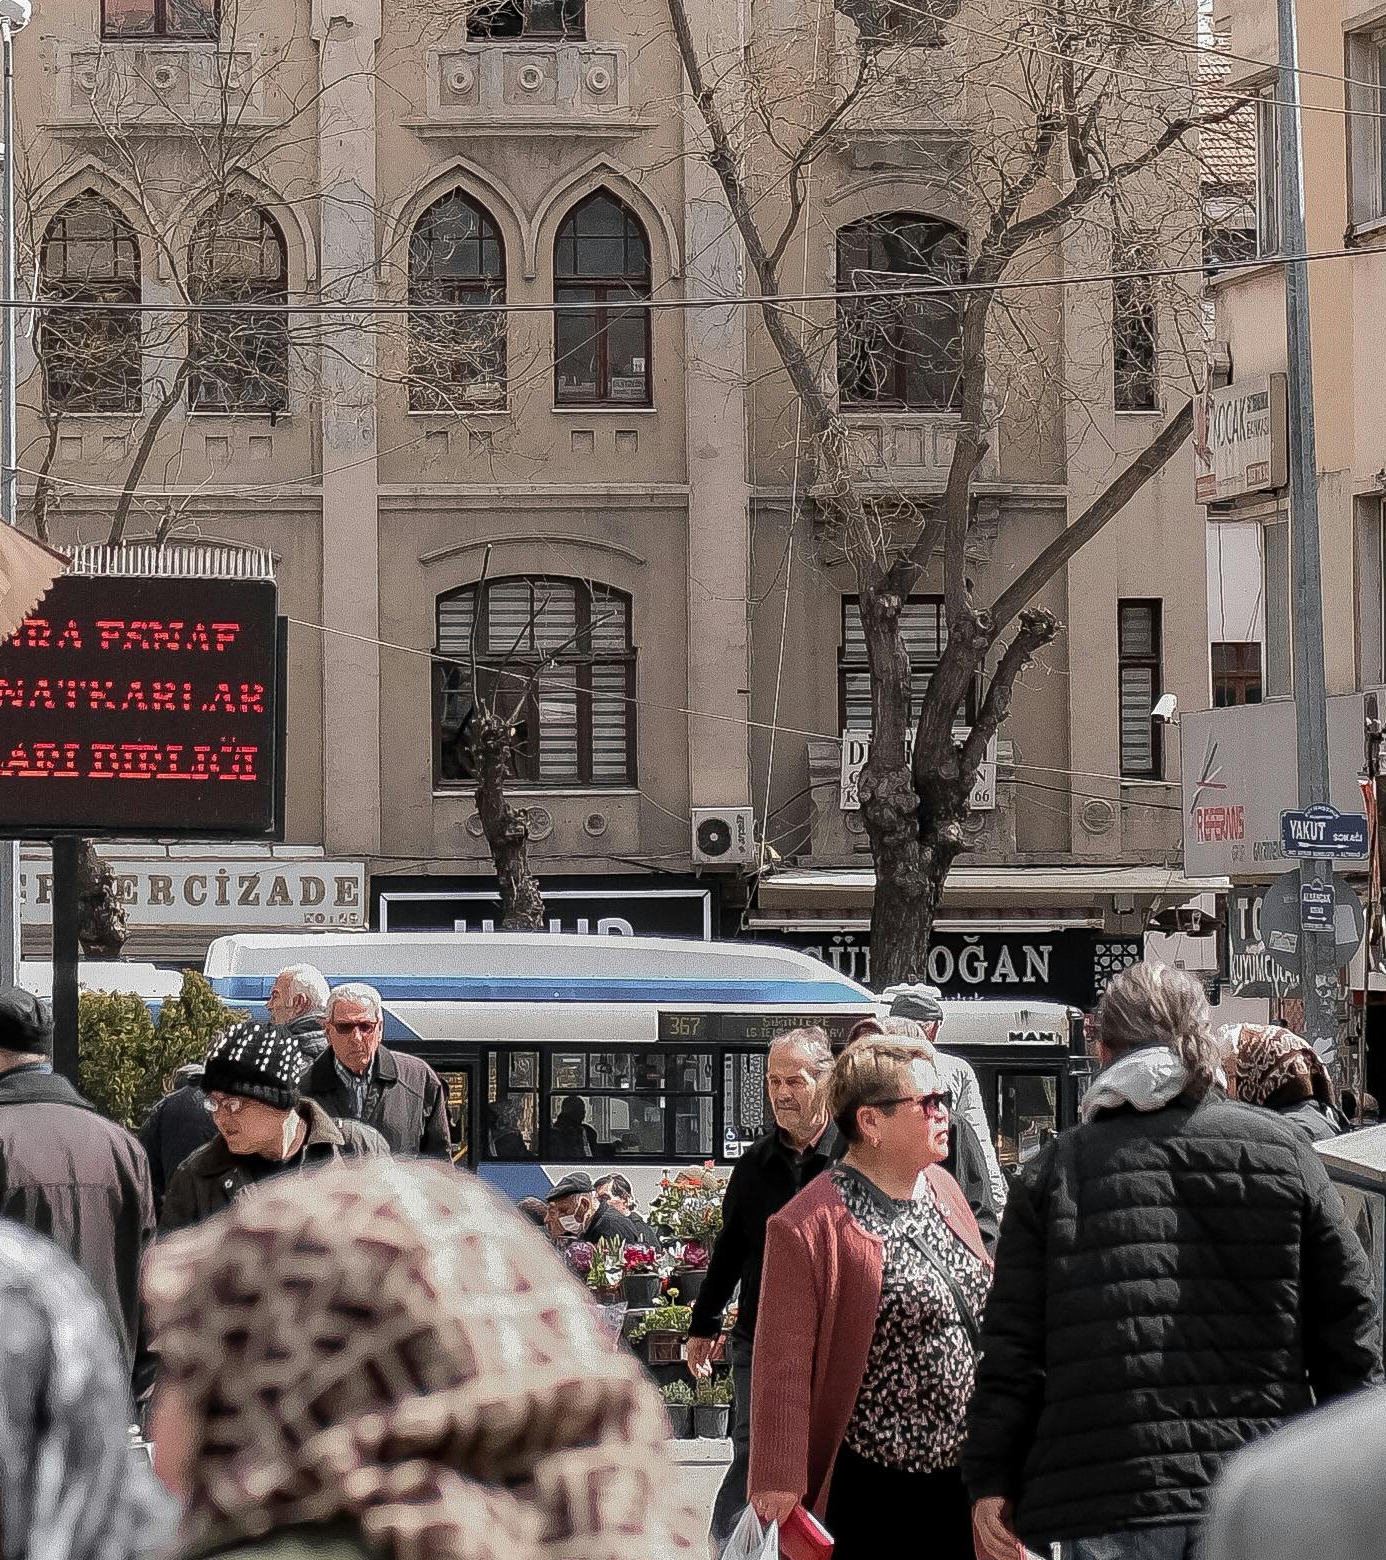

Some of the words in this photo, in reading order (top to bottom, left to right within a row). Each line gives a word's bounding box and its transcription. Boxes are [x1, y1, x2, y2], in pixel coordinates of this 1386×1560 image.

[1289, 820, 1326, 840] YAKUT
[668, 1016, 701, 1036] 367
[1009, 1031, 1054, 1042] MAN
